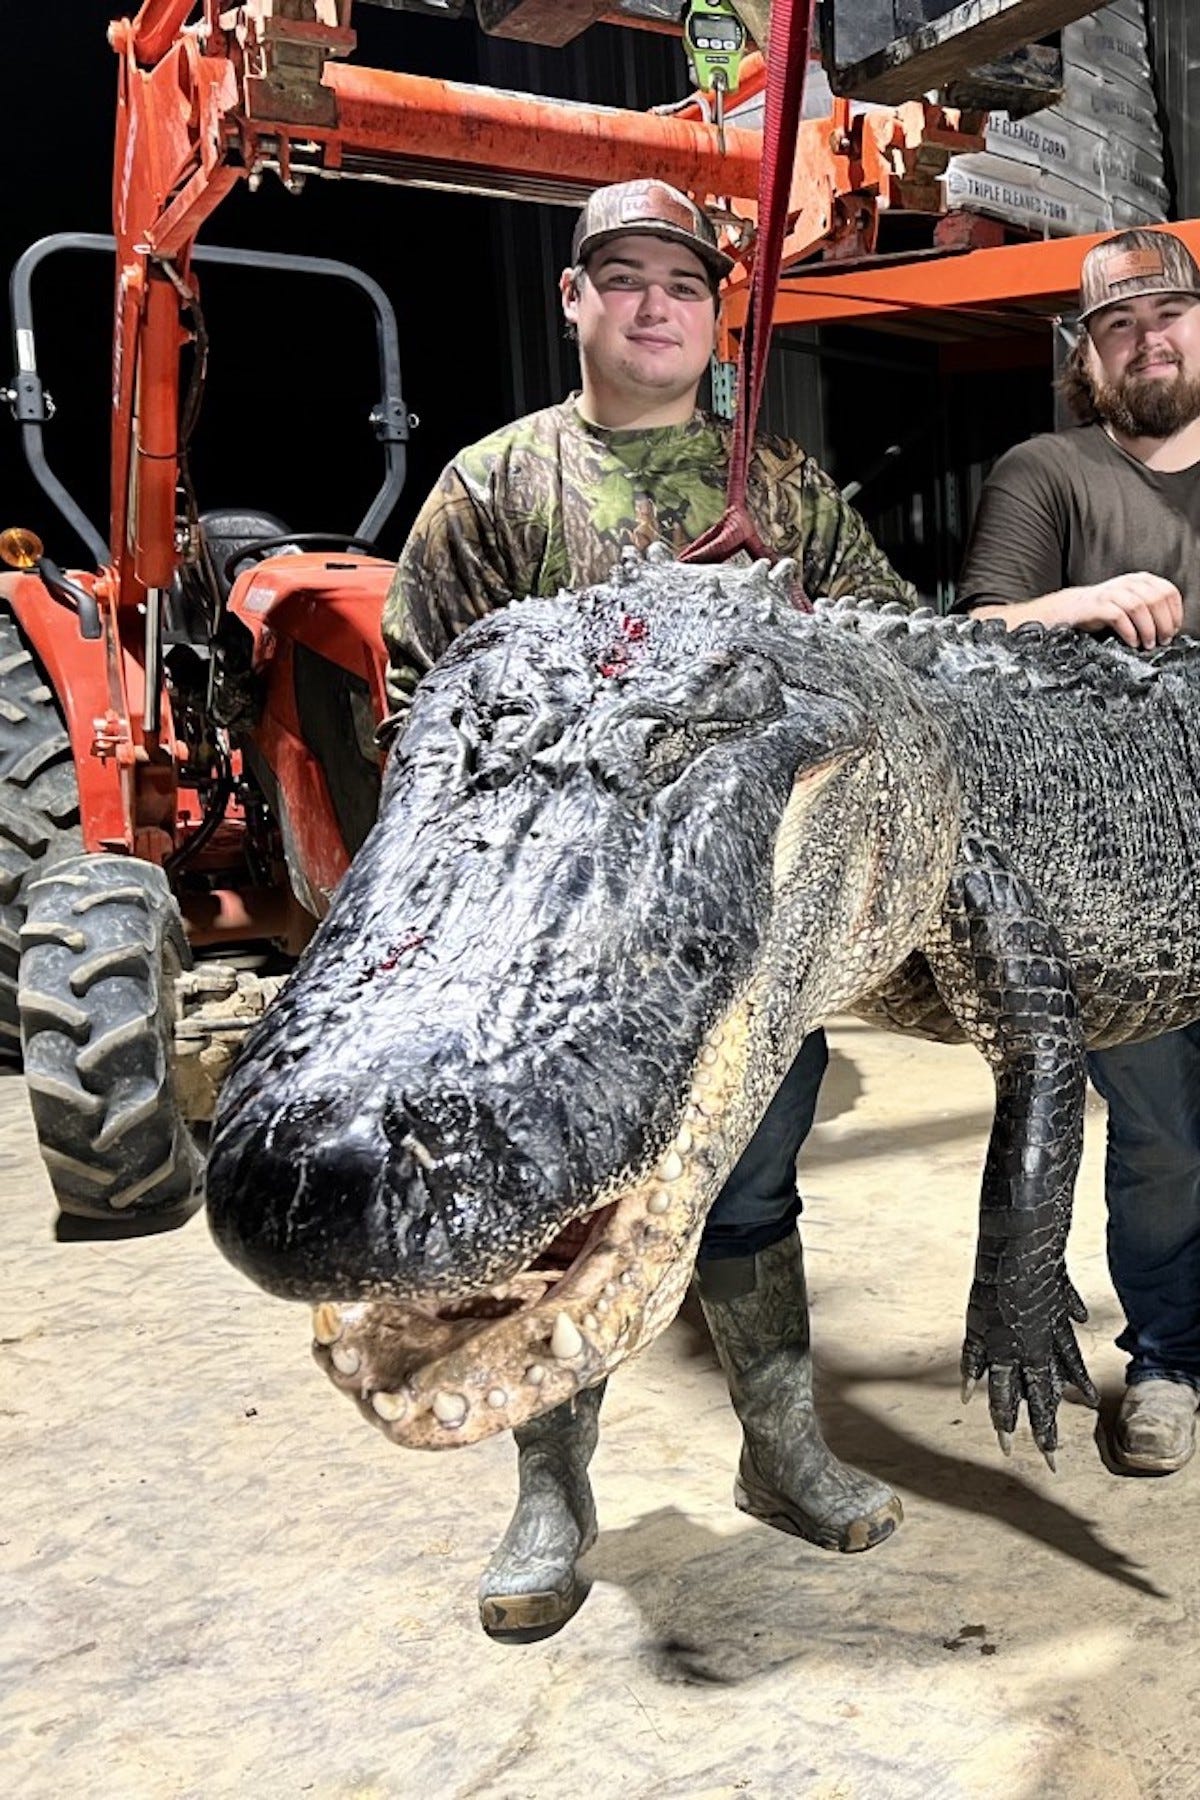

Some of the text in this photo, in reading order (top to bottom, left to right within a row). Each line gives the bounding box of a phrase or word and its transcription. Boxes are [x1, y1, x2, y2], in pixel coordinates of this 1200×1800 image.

[1002, 120, 1040, 149] CLEANED
[1042, 137, 1066, 160] CORN
[968, 179, 1000, 201] TRIPLE
